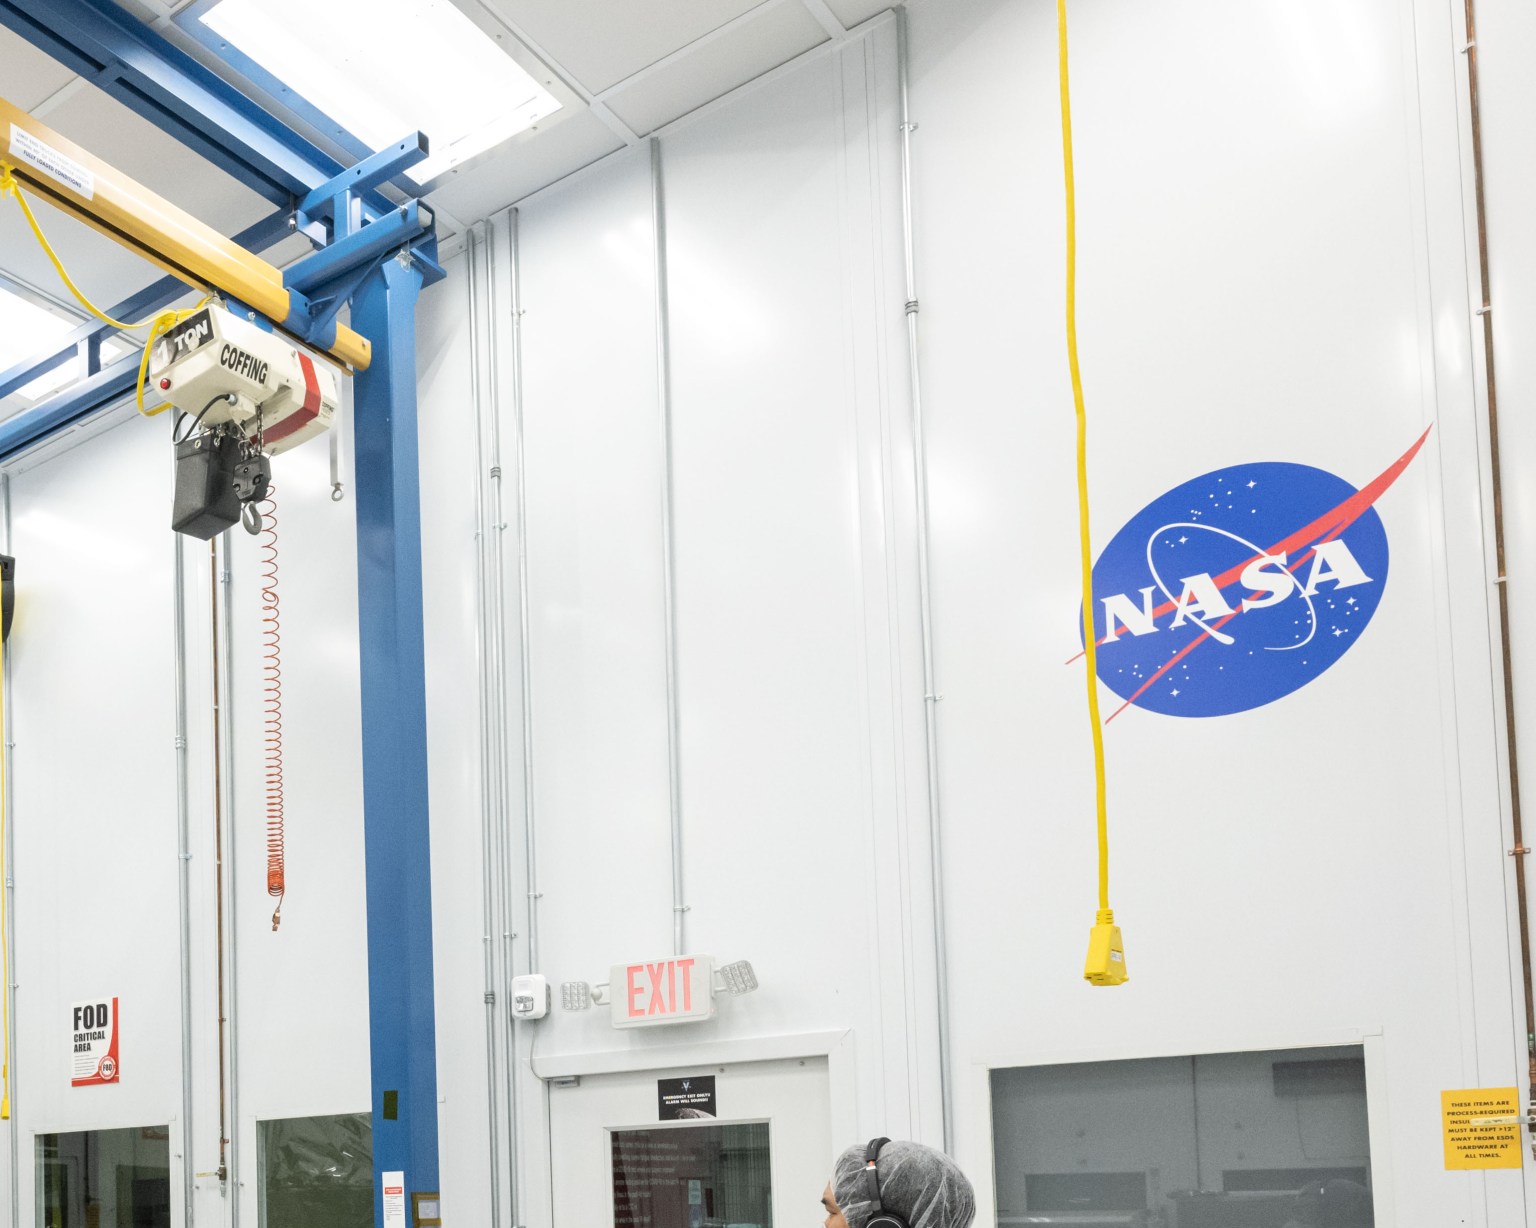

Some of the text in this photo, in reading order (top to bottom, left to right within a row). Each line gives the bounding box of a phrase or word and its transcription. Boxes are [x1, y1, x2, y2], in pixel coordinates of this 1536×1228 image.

[158, 320, 208, 362] 1 TON
[221, 344, 267, 384] COFFING
[1098, 539, 1374, 644] NASA
[627, 959, 694, 1017] EXIT
[74, 1004, 108, 1031] FOD
[74, 1031, 105, 1042] CRITICAL
[74, 1042, 91, 1052] AREA
